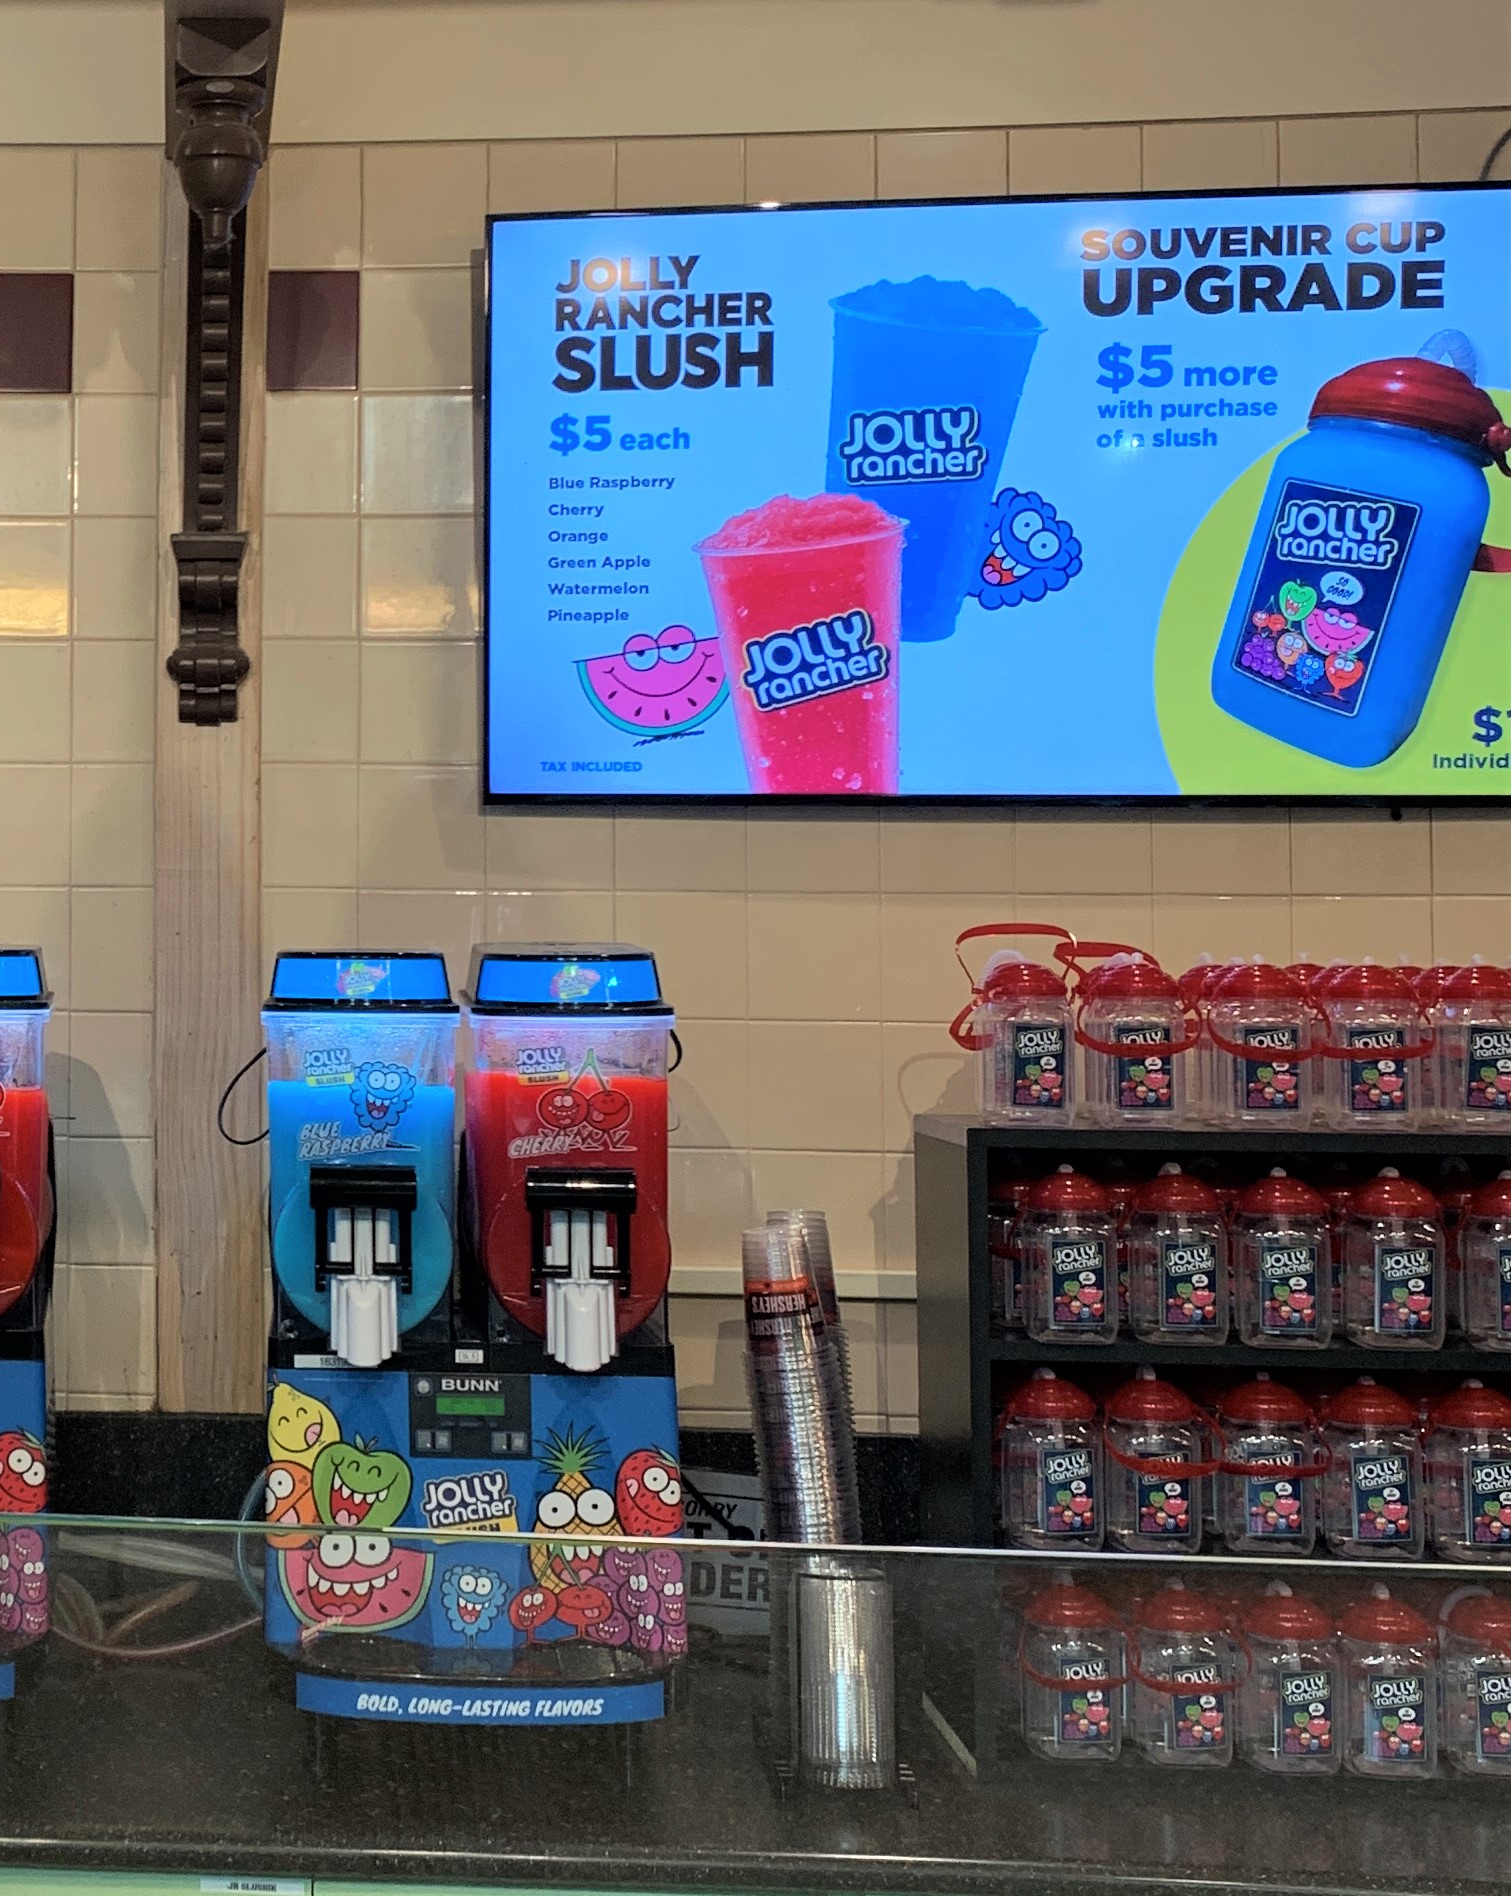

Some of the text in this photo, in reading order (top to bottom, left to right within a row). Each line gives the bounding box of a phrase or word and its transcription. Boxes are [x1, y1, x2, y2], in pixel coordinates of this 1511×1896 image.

[1080, 221, 1446, 261] SOUVENIR CUP
[554, 254, 701, 294] JOLLY
[1081, 259, 1445, 317] UPGRADE
[554, 291, 774, 332] RANCHER
[551, 332, 775, 394] SLUSH
[1096, 341, 1278, 394] $5 more
[1097, 399, 1278, 422] with purchase
[549, 413, 691, 457] $5 each
[842, 409, 975, 454] JOLLY
[1096, 429, 1123, 448] of
[1152, 428, 1218, 448] slush
[848, 445, 983, 480] rancher
[548, 474, 676, 492] Blue Raspberry
[548, 502, 605, 519] Cherry
[1284, 504, 1389, 543] JOLLY
[548, 529, 609, 546] Orange
[1282, 535, 1392, 563] rancher
[547, 555, 651, 572] Green Apple
[547, 582, 650, 596] Watermelon
[547, 608, 630, 625] Pineapple
[747, 612, 871, 684] JOLLY
[757, 648, 884, 707] rancher
[540, 761, 643, 772] TAX INCLUDED
[1433, 753, 1510, 769] Individ
[1018, 1031, 1059, 1048] JOLLY
[1021, 1043, 1061, 1055] rancher
[304, 1049, 348, 1067] JOLLY
[517, 1047, 562, 1065] JOLLY
[300, 1121, 341, 1139] BLUE
[299, 1132, 391, 1159] RASPBERRY
[510, 1135, 574, 1157] CHERRY
[1055, 1245, 1096, 1264] JOLLY
[1058, 1257, 1100, 1271] rancher
[1168, 1248, 1208, 1266] JOLLY
[1265, 1250, 1307, 1268] JOLLY
[1384, 1252, 1425, 1270] JOLLY
[1171, 1260, 1212, 1273] rancher
[1268, 1262, 1311, 1276] rancher
[1387, 1263, 1430, 1278] rancher
[441, 1378, 499, 1392] BUNN
[1047, 1453, 1086, 1474] JOLLY
[1357, 1459, 1399, 1479] JOLLY
[1050, 1466, 1089, 1482] rancher
[1361, 1472, 1404, 1487] rancher
[425, 1474, 503, 1510] JOLLY
[432, 1499, 512, 1526] rancher
[690, 1562, 770, 1602] DER
[1065, 1661, 1103, 1680] JOLLY
[1285, 1675, 1325, 1695] JOLLY
[1374, 1680, 1416, 1699] JOLLY
[357, 1693, 605, 1717] BOLD, LONG-LASTING FLAVORS
[1289, 1688, 1329, 1703] rancher
[1377, 1693, 1420, 1705] rancher
